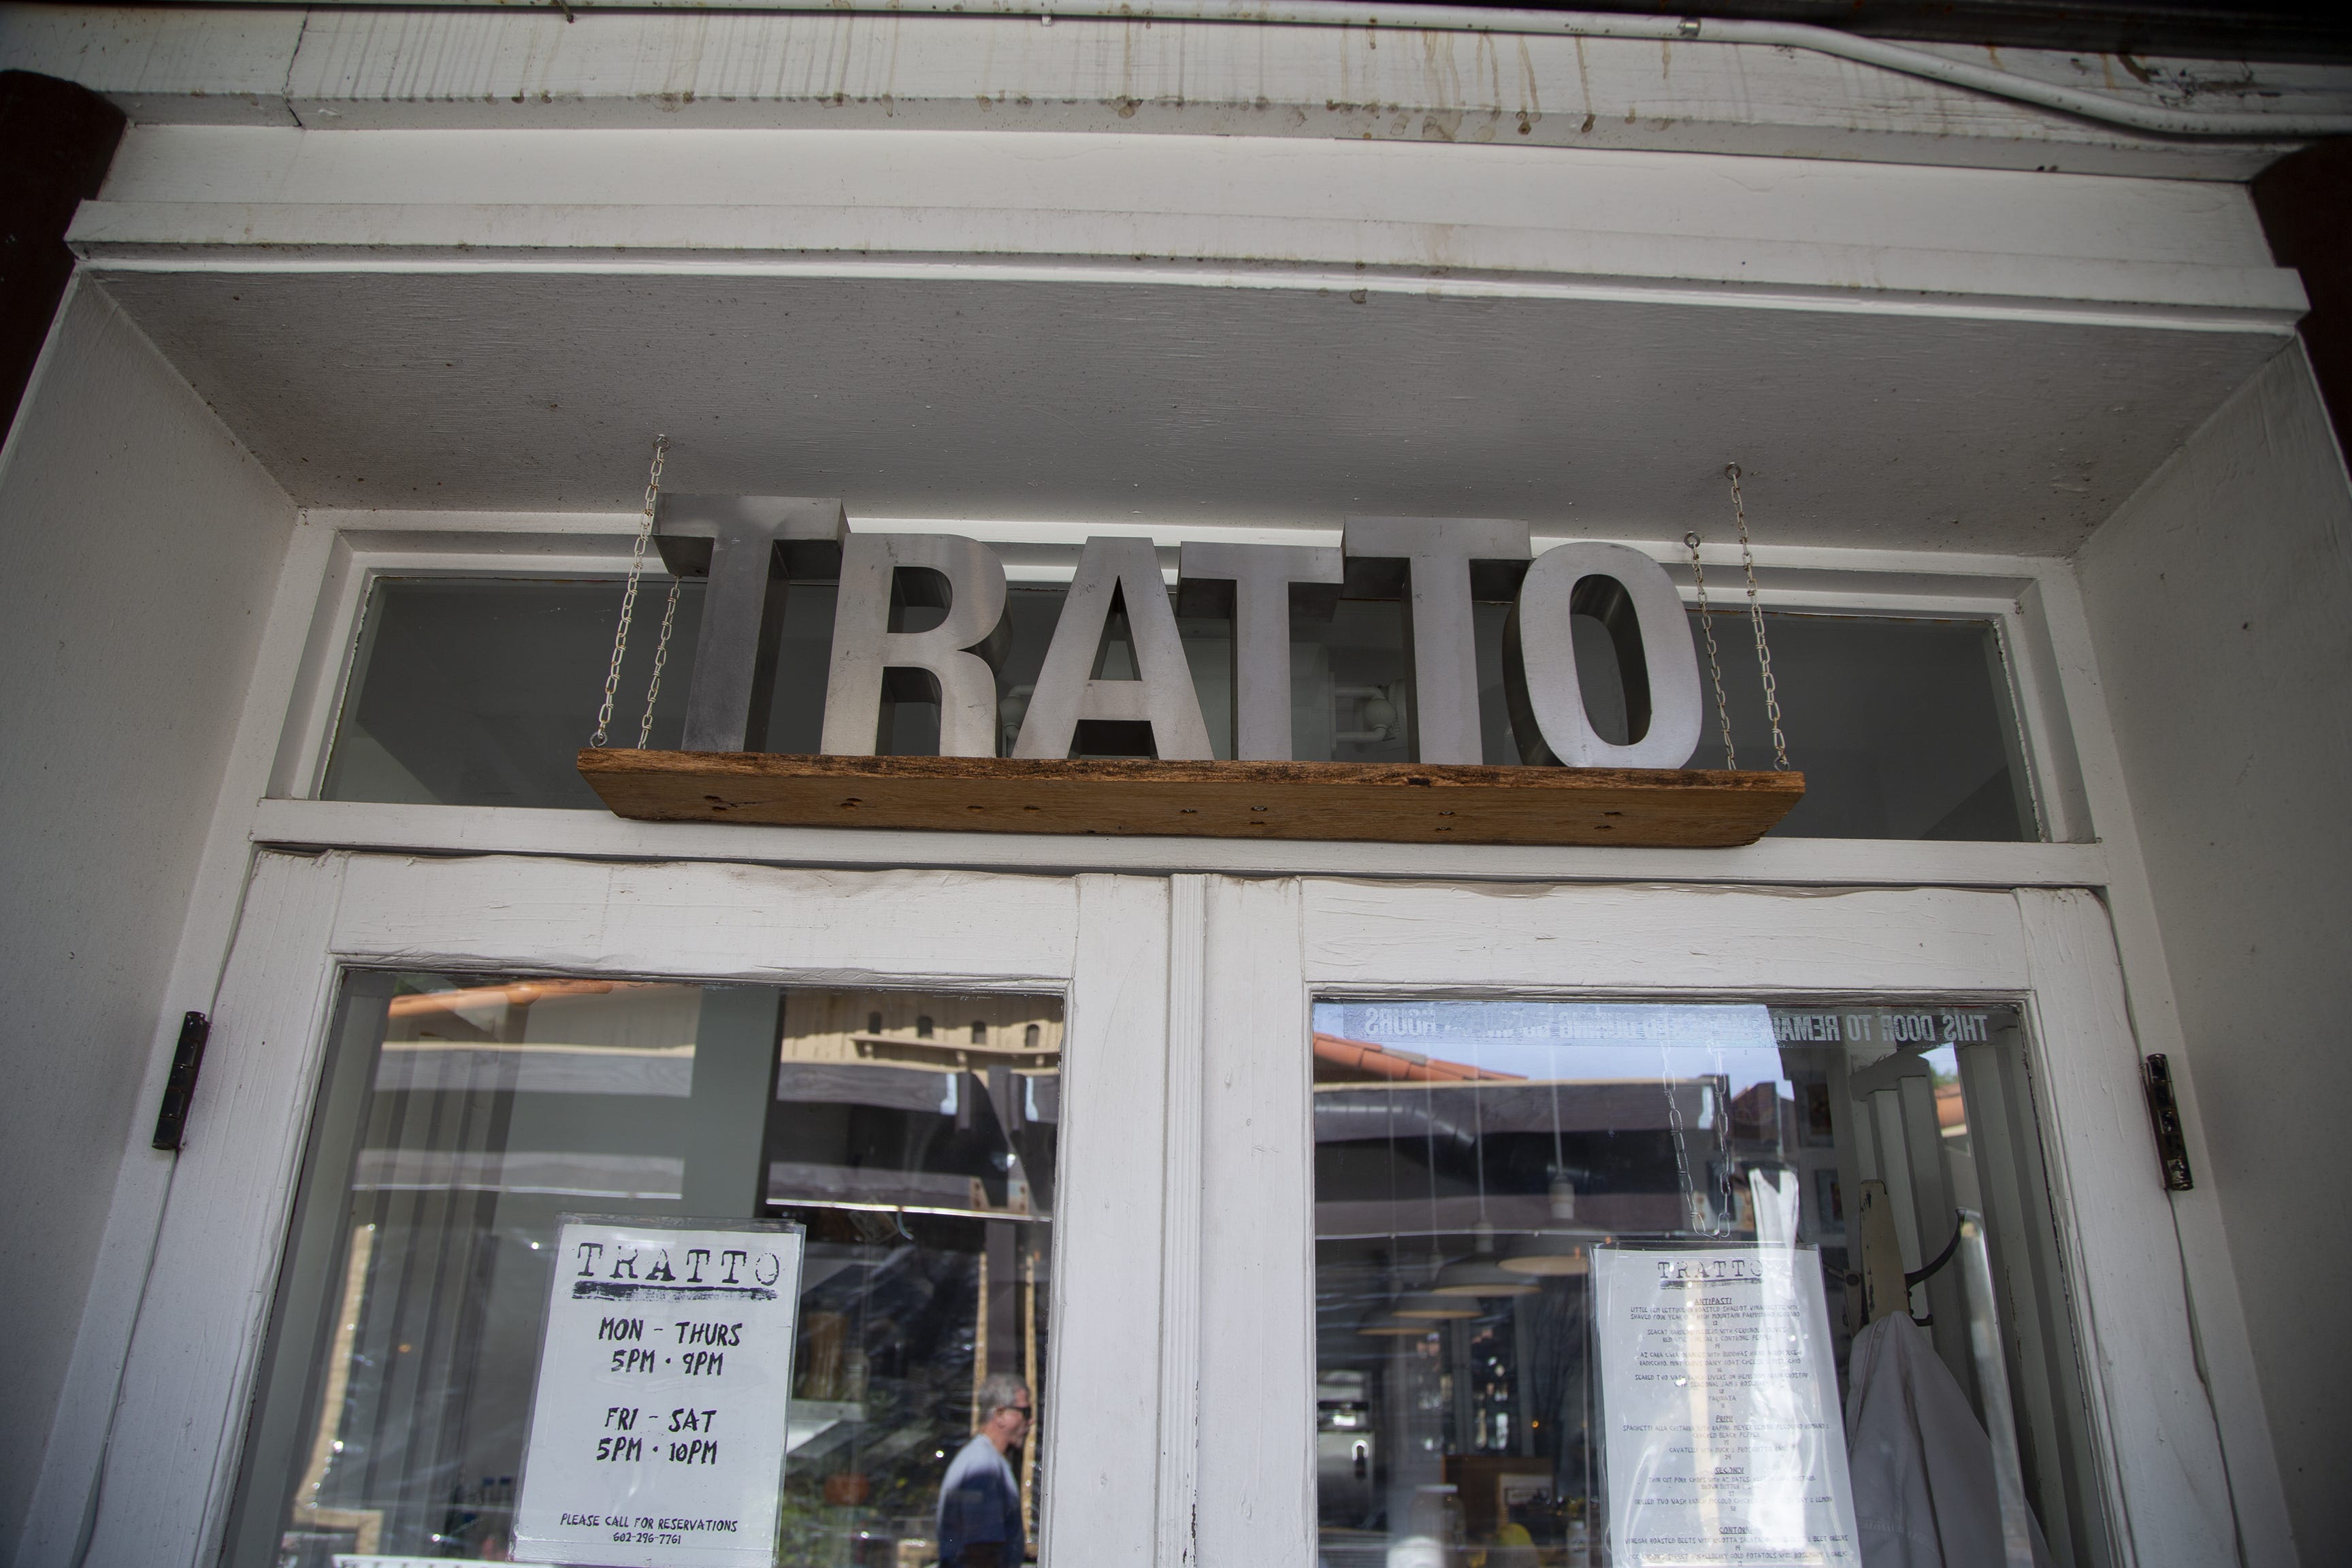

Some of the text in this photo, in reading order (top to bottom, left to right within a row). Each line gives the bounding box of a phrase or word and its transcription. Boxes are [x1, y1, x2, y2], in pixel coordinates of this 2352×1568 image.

[653, 493, 1703, 770] TRATTO
[576, 1243, 781, 1286] TRATTO
[1657, 1259, 1763, 1279] TRATTO
[599, 1317, 644, 1342] MON
[675, 1322, 743, 1347] THURS
[611, 1349, 724, 1376] 5PM 9PM
[604, 1407, 639, 1431] FRI
[668, 1408, 717, 1433] SAT
[595, 1437, 718, 1465] 5PM 10PM
[1714, 1467, 1745, 1475] SECONDI
[560, 1513, 738, 1533] PLEASE CALL FOR RESERVATIONS
[612, 1531, 681, 1545] 602-296-7761
